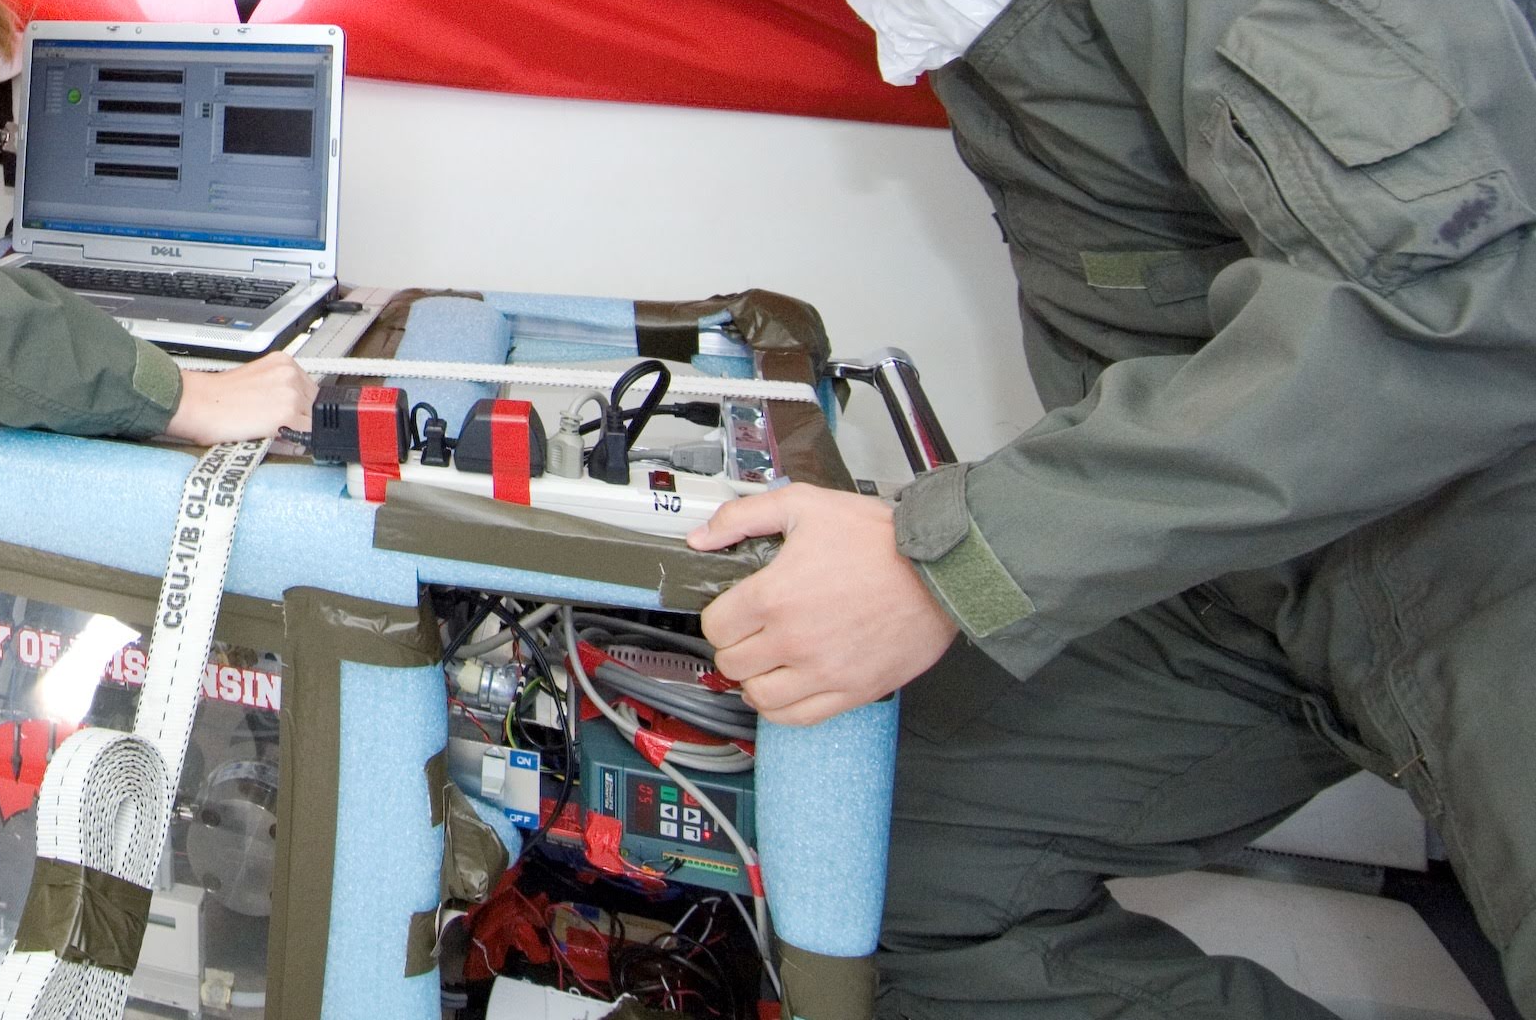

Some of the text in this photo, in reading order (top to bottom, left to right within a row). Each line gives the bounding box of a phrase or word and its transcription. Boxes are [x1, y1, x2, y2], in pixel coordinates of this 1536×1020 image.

[151, 245, 182, 258] DELL
[214, 468, 246, 508] 5000
[163, 526, 201, 629] CGU-1/B
[185, 476, 212, 519] CL2
[18, 628, 62, 668] OF
[516, 755, 532, 767] ON
[509, 813, 531, 825] OFF
